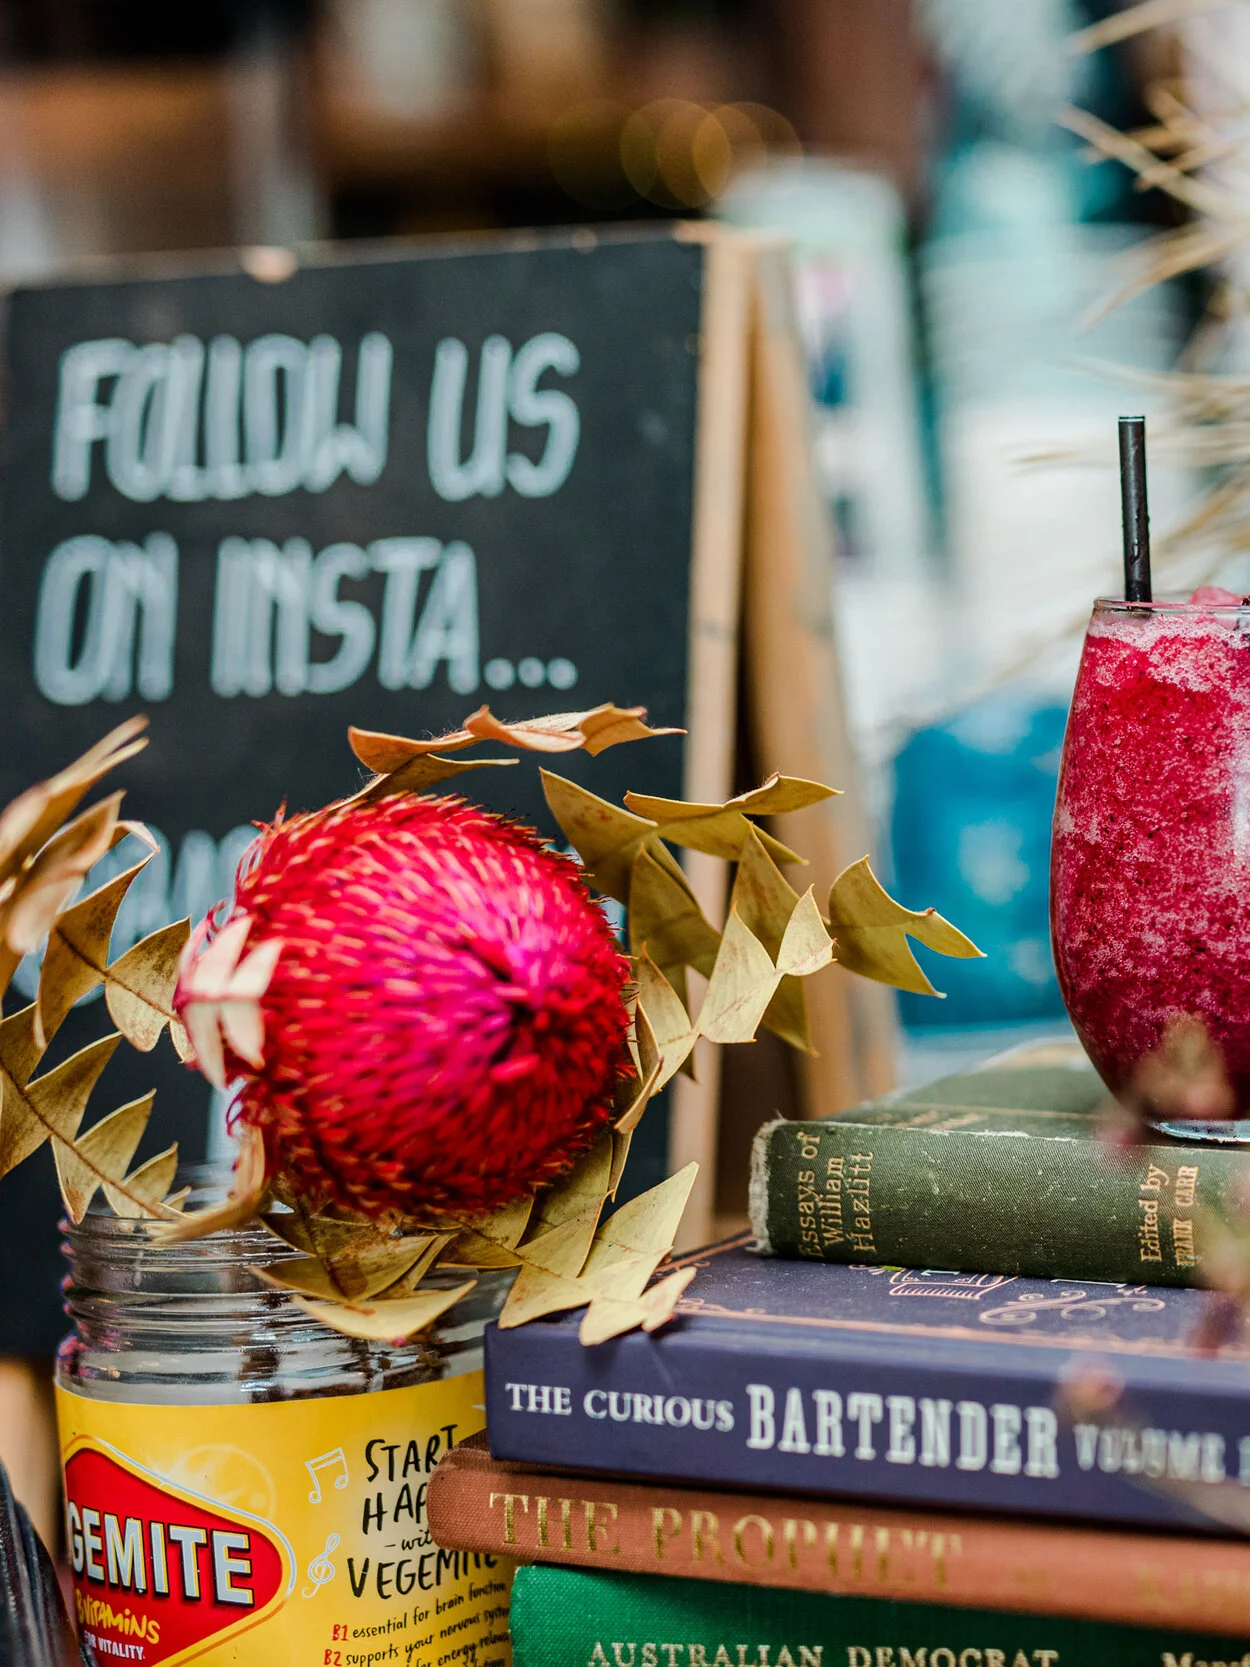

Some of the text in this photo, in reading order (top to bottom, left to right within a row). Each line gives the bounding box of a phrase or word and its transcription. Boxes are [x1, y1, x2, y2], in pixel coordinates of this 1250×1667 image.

[51, 330, 580, 501] FOLLOW US
[34, 531, 578, 705] ON INSTA...
[796, 1131, 825, 1257] Essays of
[819, 1156, 845, 1247] William
[846, 1151, 877, 1252] Hazlitt
[1139, 1163, 1170, 1262] Edited by
[364, 1424, 459, 1483] START
[506, 1383, 572, 1415] THE
[583, 1389, 735, 1432] CURIOUS
[745, 1383, 1060, 1480] BARTENDER
[1073, 1424, 1227, 1484] VOLUME
[490, 1493, 963, 1589] THE PROPHET
[323, 1649, 342, 1667] B2
[346, 1643, 400, 1667] supports
[405, 1634, 434, 1662] your
[332, 1623, 348, 1641] B1
[352, 1612, 408, 1639] essential
[413, 1606, 430, 1626] for
[436, 1596, 464, 1615] brain
[588, 1642, 825, 1667] AUSTRALIAN
[846, 1646, 1061, 1667] DEMOCRAT
